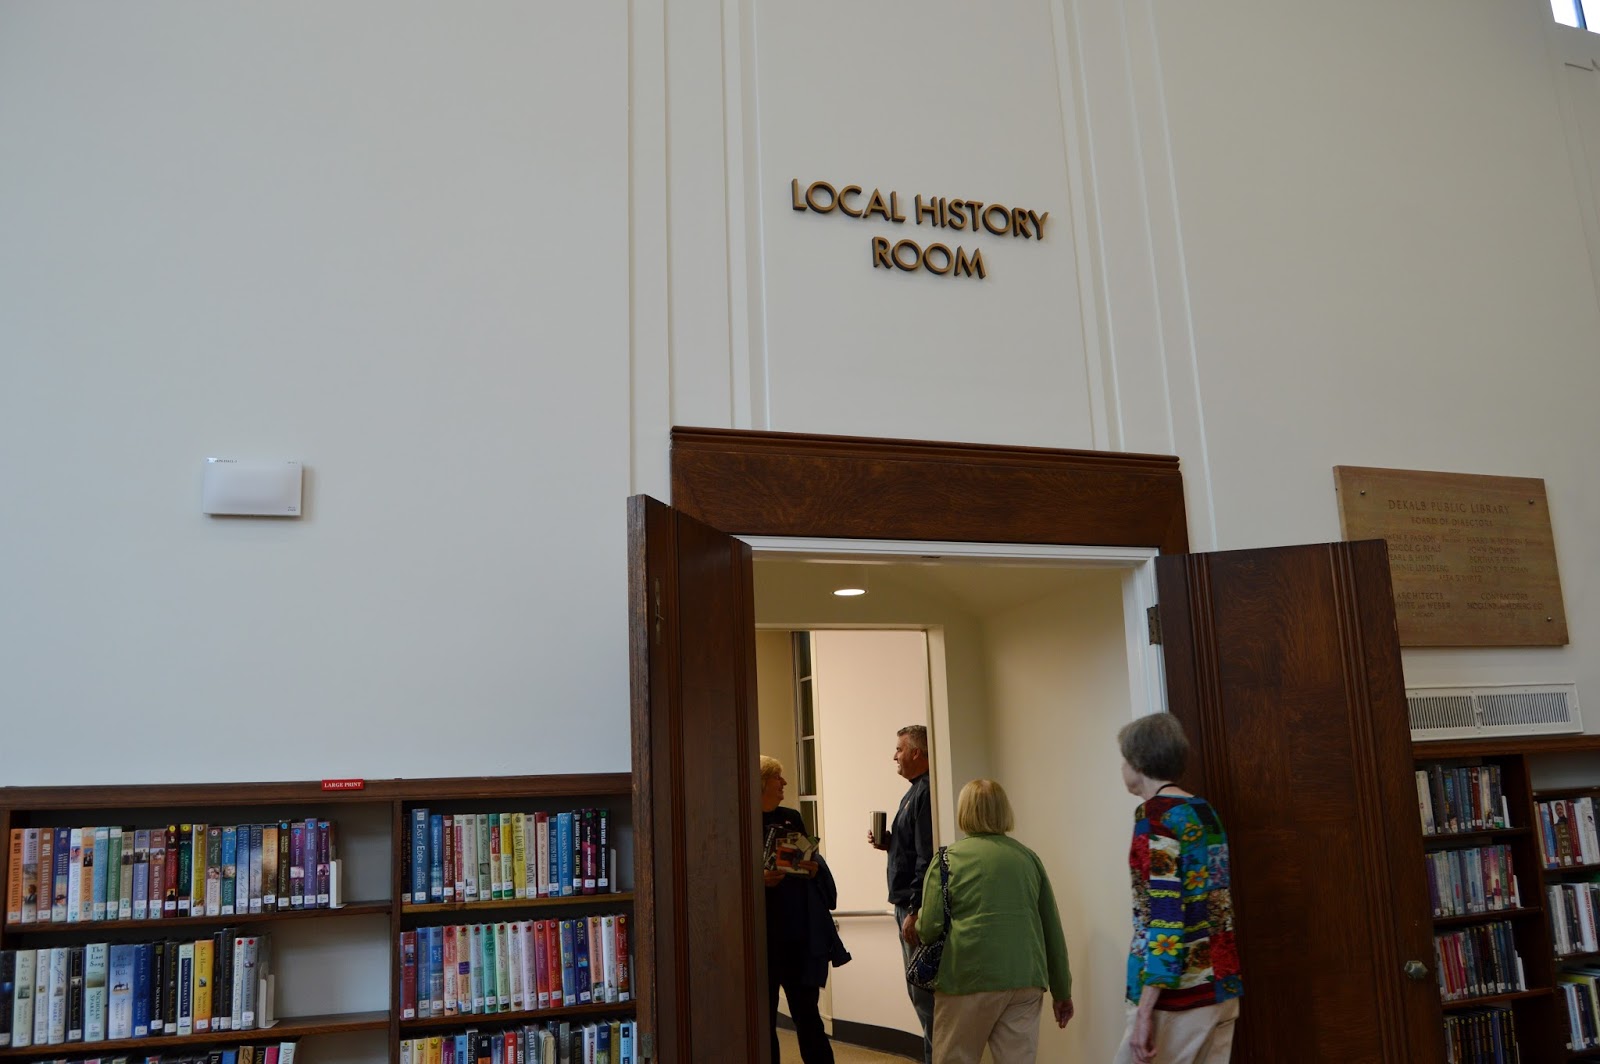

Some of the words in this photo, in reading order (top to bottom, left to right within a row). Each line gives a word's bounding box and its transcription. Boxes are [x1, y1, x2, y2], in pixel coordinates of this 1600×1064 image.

[791, 178, 906, 223] LOCAL
[914, 194, 1049, 241] HISTORY
[871, 236, 987, 279] ROOM
[1388, 499, 1427, 512] DEKALB
[1431, 501, 1467, 513] PUBLIC
[1470, 503, 1511, 515] LIBRARY
[417, 824, 425, 840] EAST
[417, 845, 425, 864] EDEN
[526, 862, 535, 875] AMY
[526, 874, 535, 884] TAN
[11, 883, 19, 907] SNELLING
[528, 1031, 536, 1049] SCOTT
